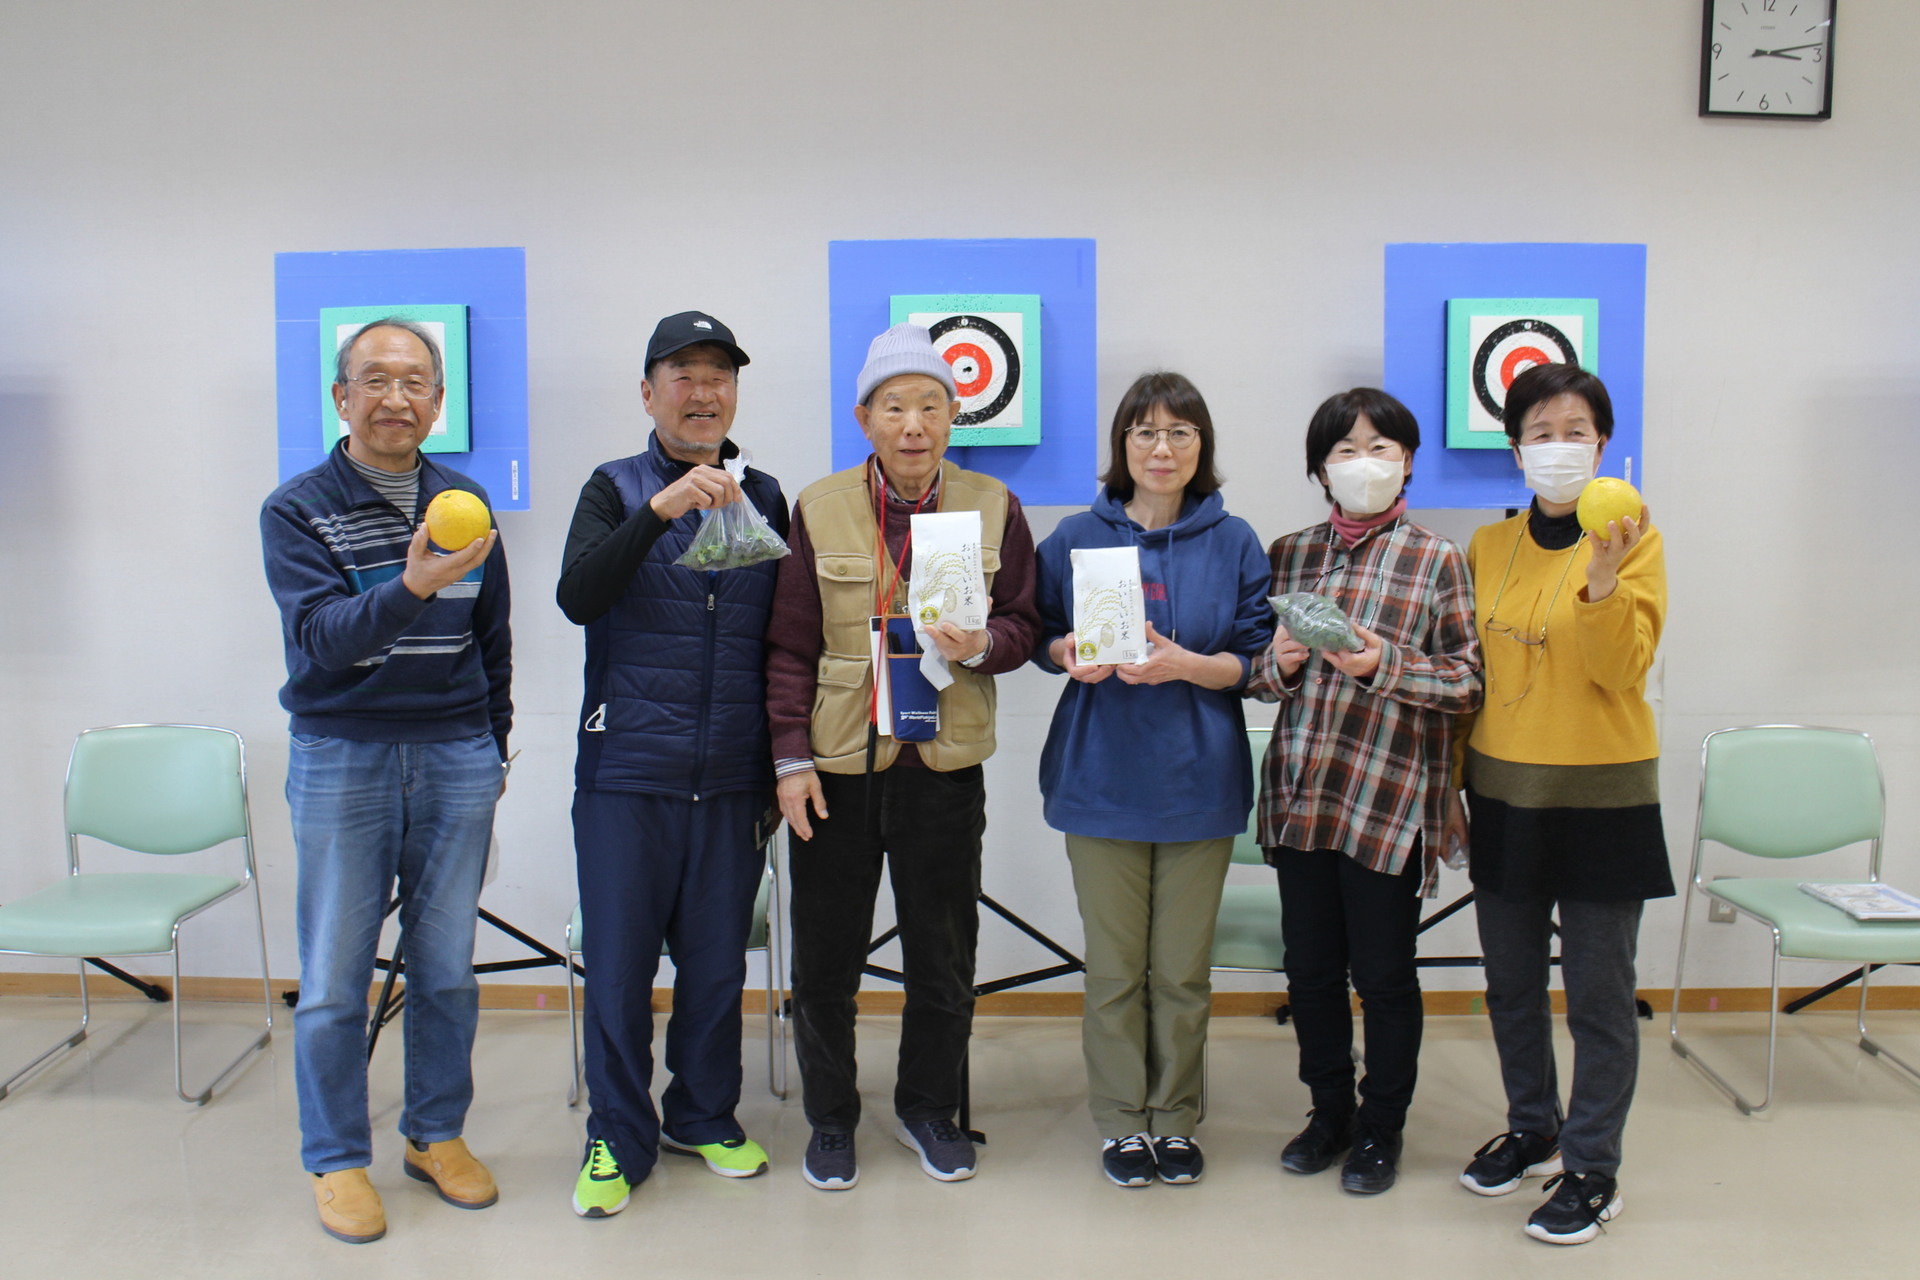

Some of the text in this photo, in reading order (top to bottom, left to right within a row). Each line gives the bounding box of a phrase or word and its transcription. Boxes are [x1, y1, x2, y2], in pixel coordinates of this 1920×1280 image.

[1763, 0, 1776, 11] 12
[1712, 43, 1722, 60] 9
[1812, 48, 1822, 63] 3
[1759, 94, 1769, 110] 6
[961, 544, 973, 606] おいしいお米
[1118, 580, 1130, 641] おいしいお米
